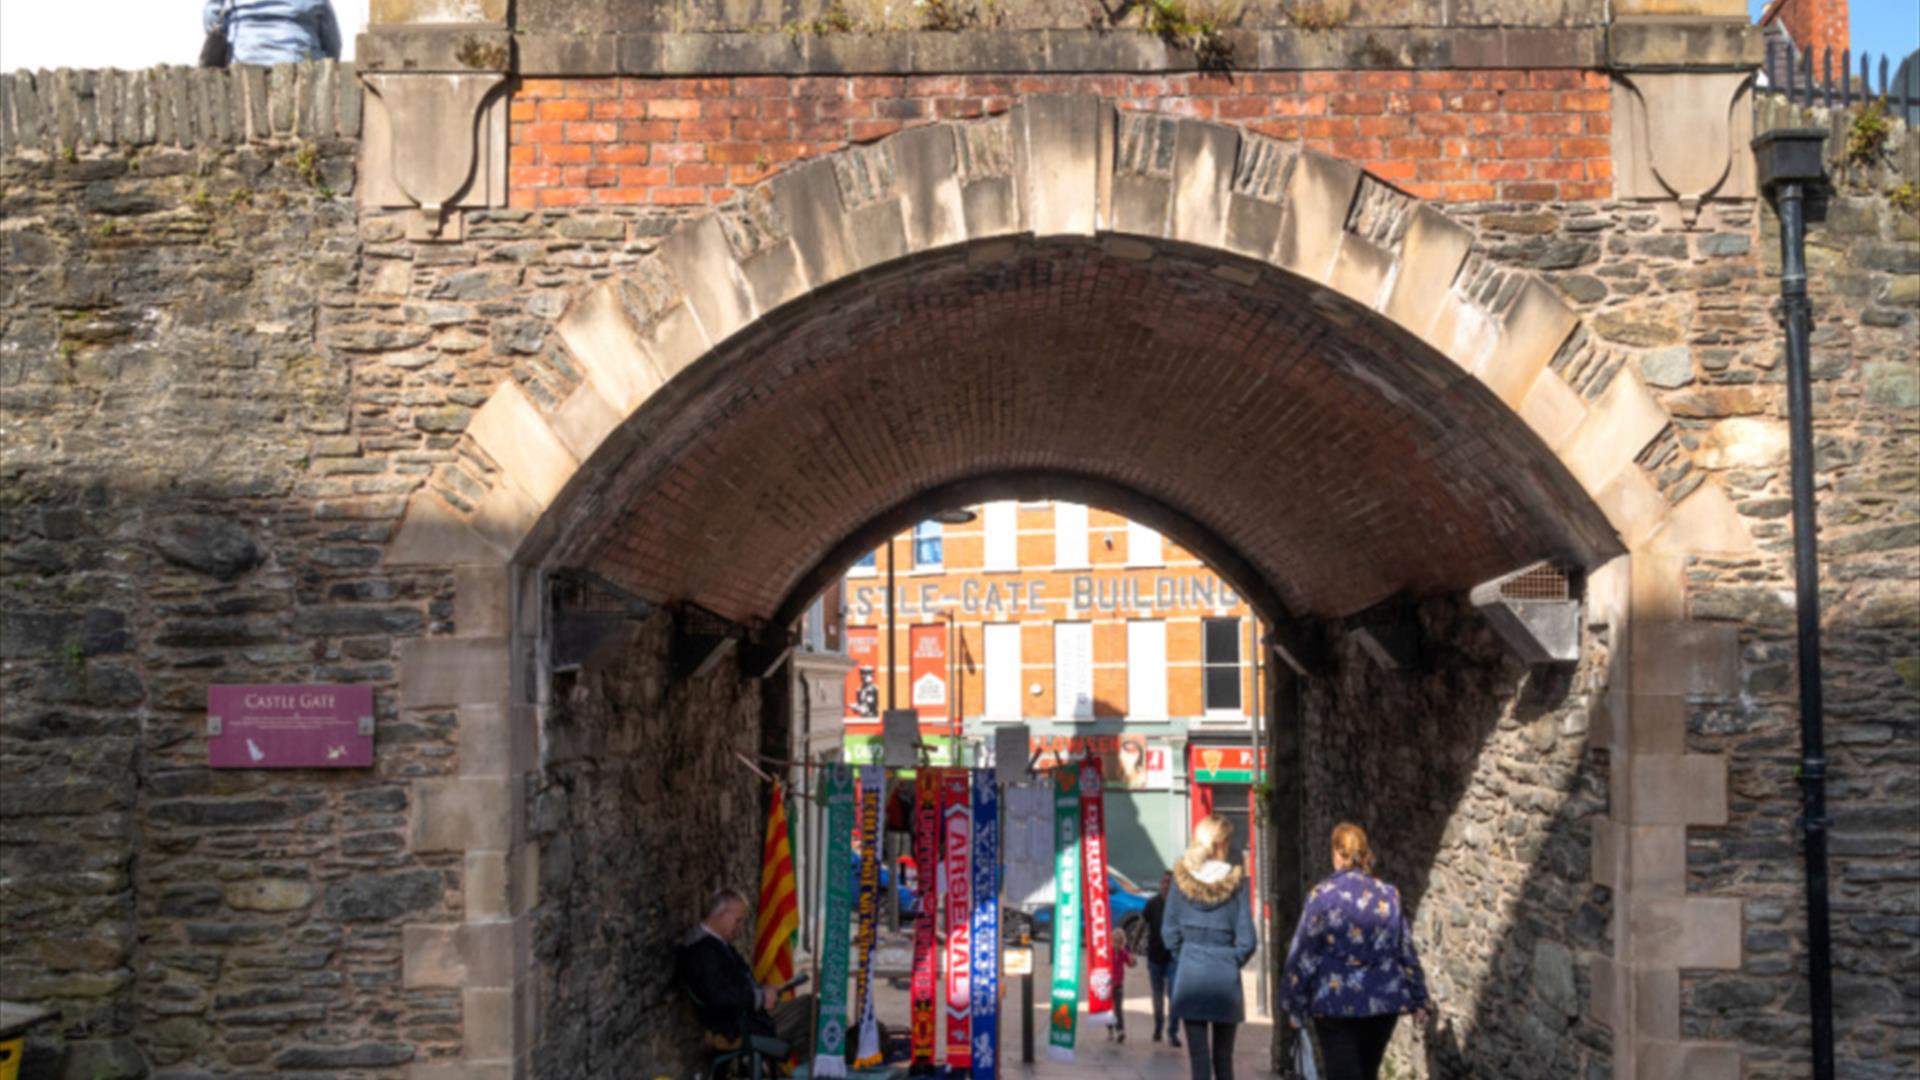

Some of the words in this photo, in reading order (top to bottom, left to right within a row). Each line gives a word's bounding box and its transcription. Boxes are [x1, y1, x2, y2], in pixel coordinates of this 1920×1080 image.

[845, 579, 1047, 616] STLE-GATE
[244, 693, 296, 709] CASTLE
[299, 693, 336, 709] GATE
[1084, 804, 1105, 893] DERRY
[951, 832, 969, 993] ARSENAL
[1090, 898, 1109, 960] CITY
